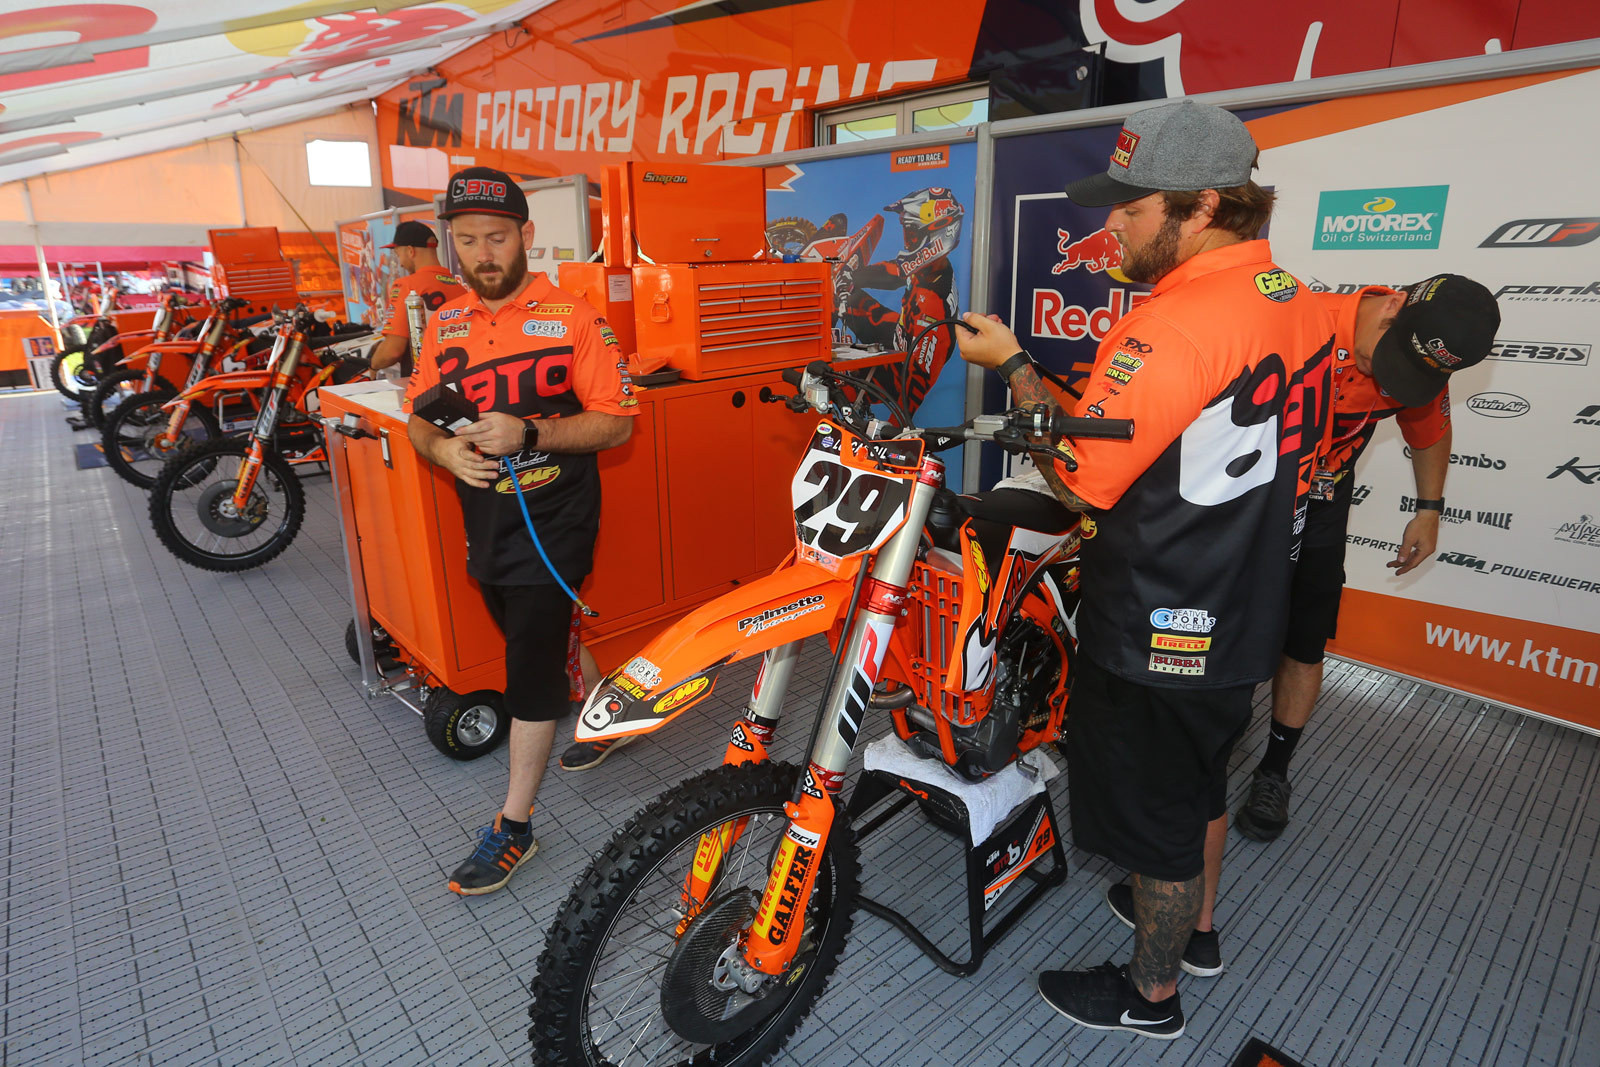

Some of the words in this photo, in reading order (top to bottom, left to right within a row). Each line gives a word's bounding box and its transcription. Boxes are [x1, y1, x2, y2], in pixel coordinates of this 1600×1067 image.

[474, 79, 640, 153] FACTORY
[897, 156, 916, 164] READY
[917, 154, 925, 163] TO
[926, 152, 942, 162] RACE
[643, 172, 688, 185] Snap-on
[1322, 213, 1433, 233] MOTOREX
[1321, 232, 1335, 243] Oil
[1341, 232, 1354, 242] of
[1357, 232, 1432, 242] Switzerland
[902, 254, 922, 276] Red
[921, 238, 944, 263] Bull
[1031, 288, 1125, 342] Red
[496, 466, 560, 493] FMF
[794, 460, 905, 558] 29
[1440, 516, 1465, 525] ITALY
[1476, 510, 1514, 531] VALLE
[738, 594, 825, 632] Palmetto
[745, 603, 826, 638] Motorsports
[1163, 614, 1216, 626] SPORTS
[1156, 636, 1206, 649] PIRELLI
[1153, 655, 1202, 668] BUBBA
[1153, 664, 1201, 674] burger
[653, 676, 709, 714] FMF
[446, 708, 460, 747] DUNLOP
[1035, 826, 1051, 854] 29
[768, 844, 813, 946] GALFER
